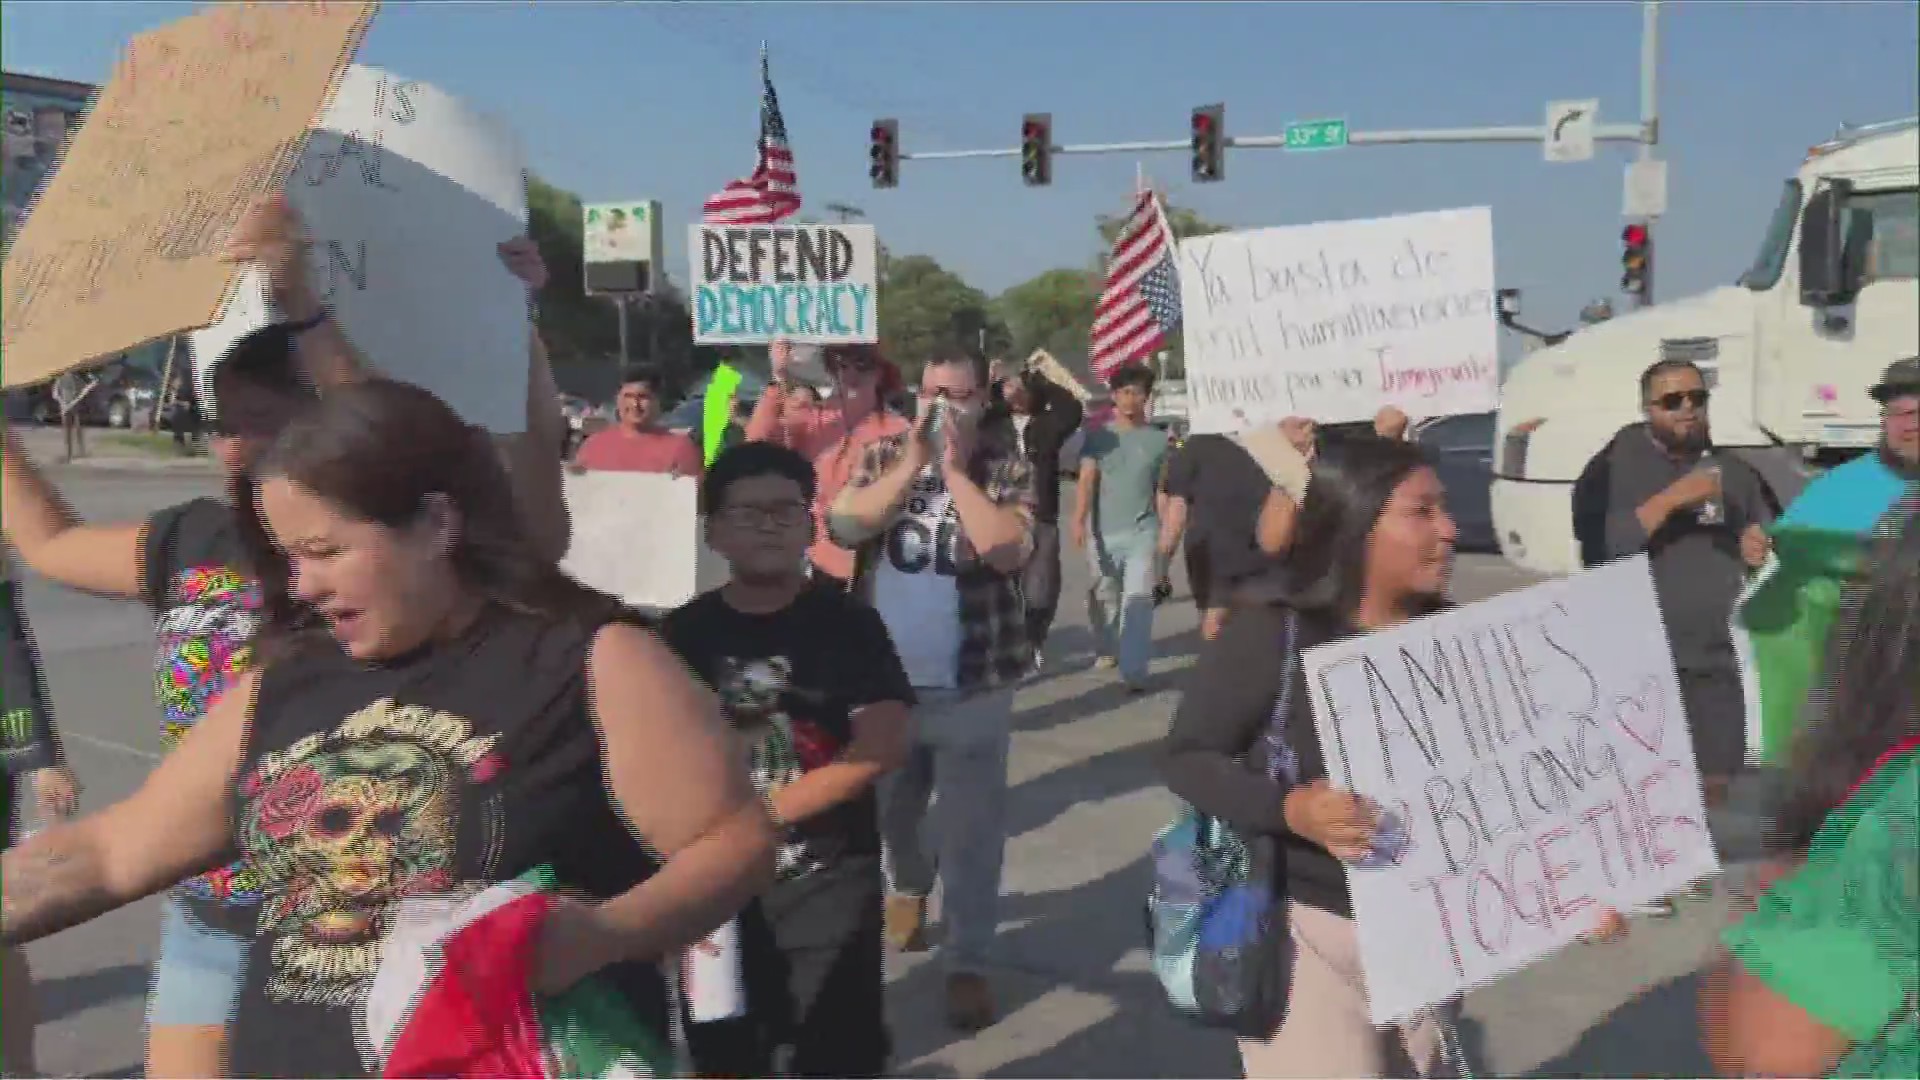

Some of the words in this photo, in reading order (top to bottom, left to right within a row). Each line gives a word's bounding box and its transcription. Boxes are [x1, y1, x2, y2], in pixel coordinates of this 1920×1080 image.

[702, 228, 853, 284] DEFEND
[1188, 240, 1232, 316] Ya
[1391, 238, 1449, 282] de
[697, 283, 870, 337] DEMOCRACY
[1316, 600, 1600, 800] FAMILIES
[1424, 716, 1622, 874] BELONG
